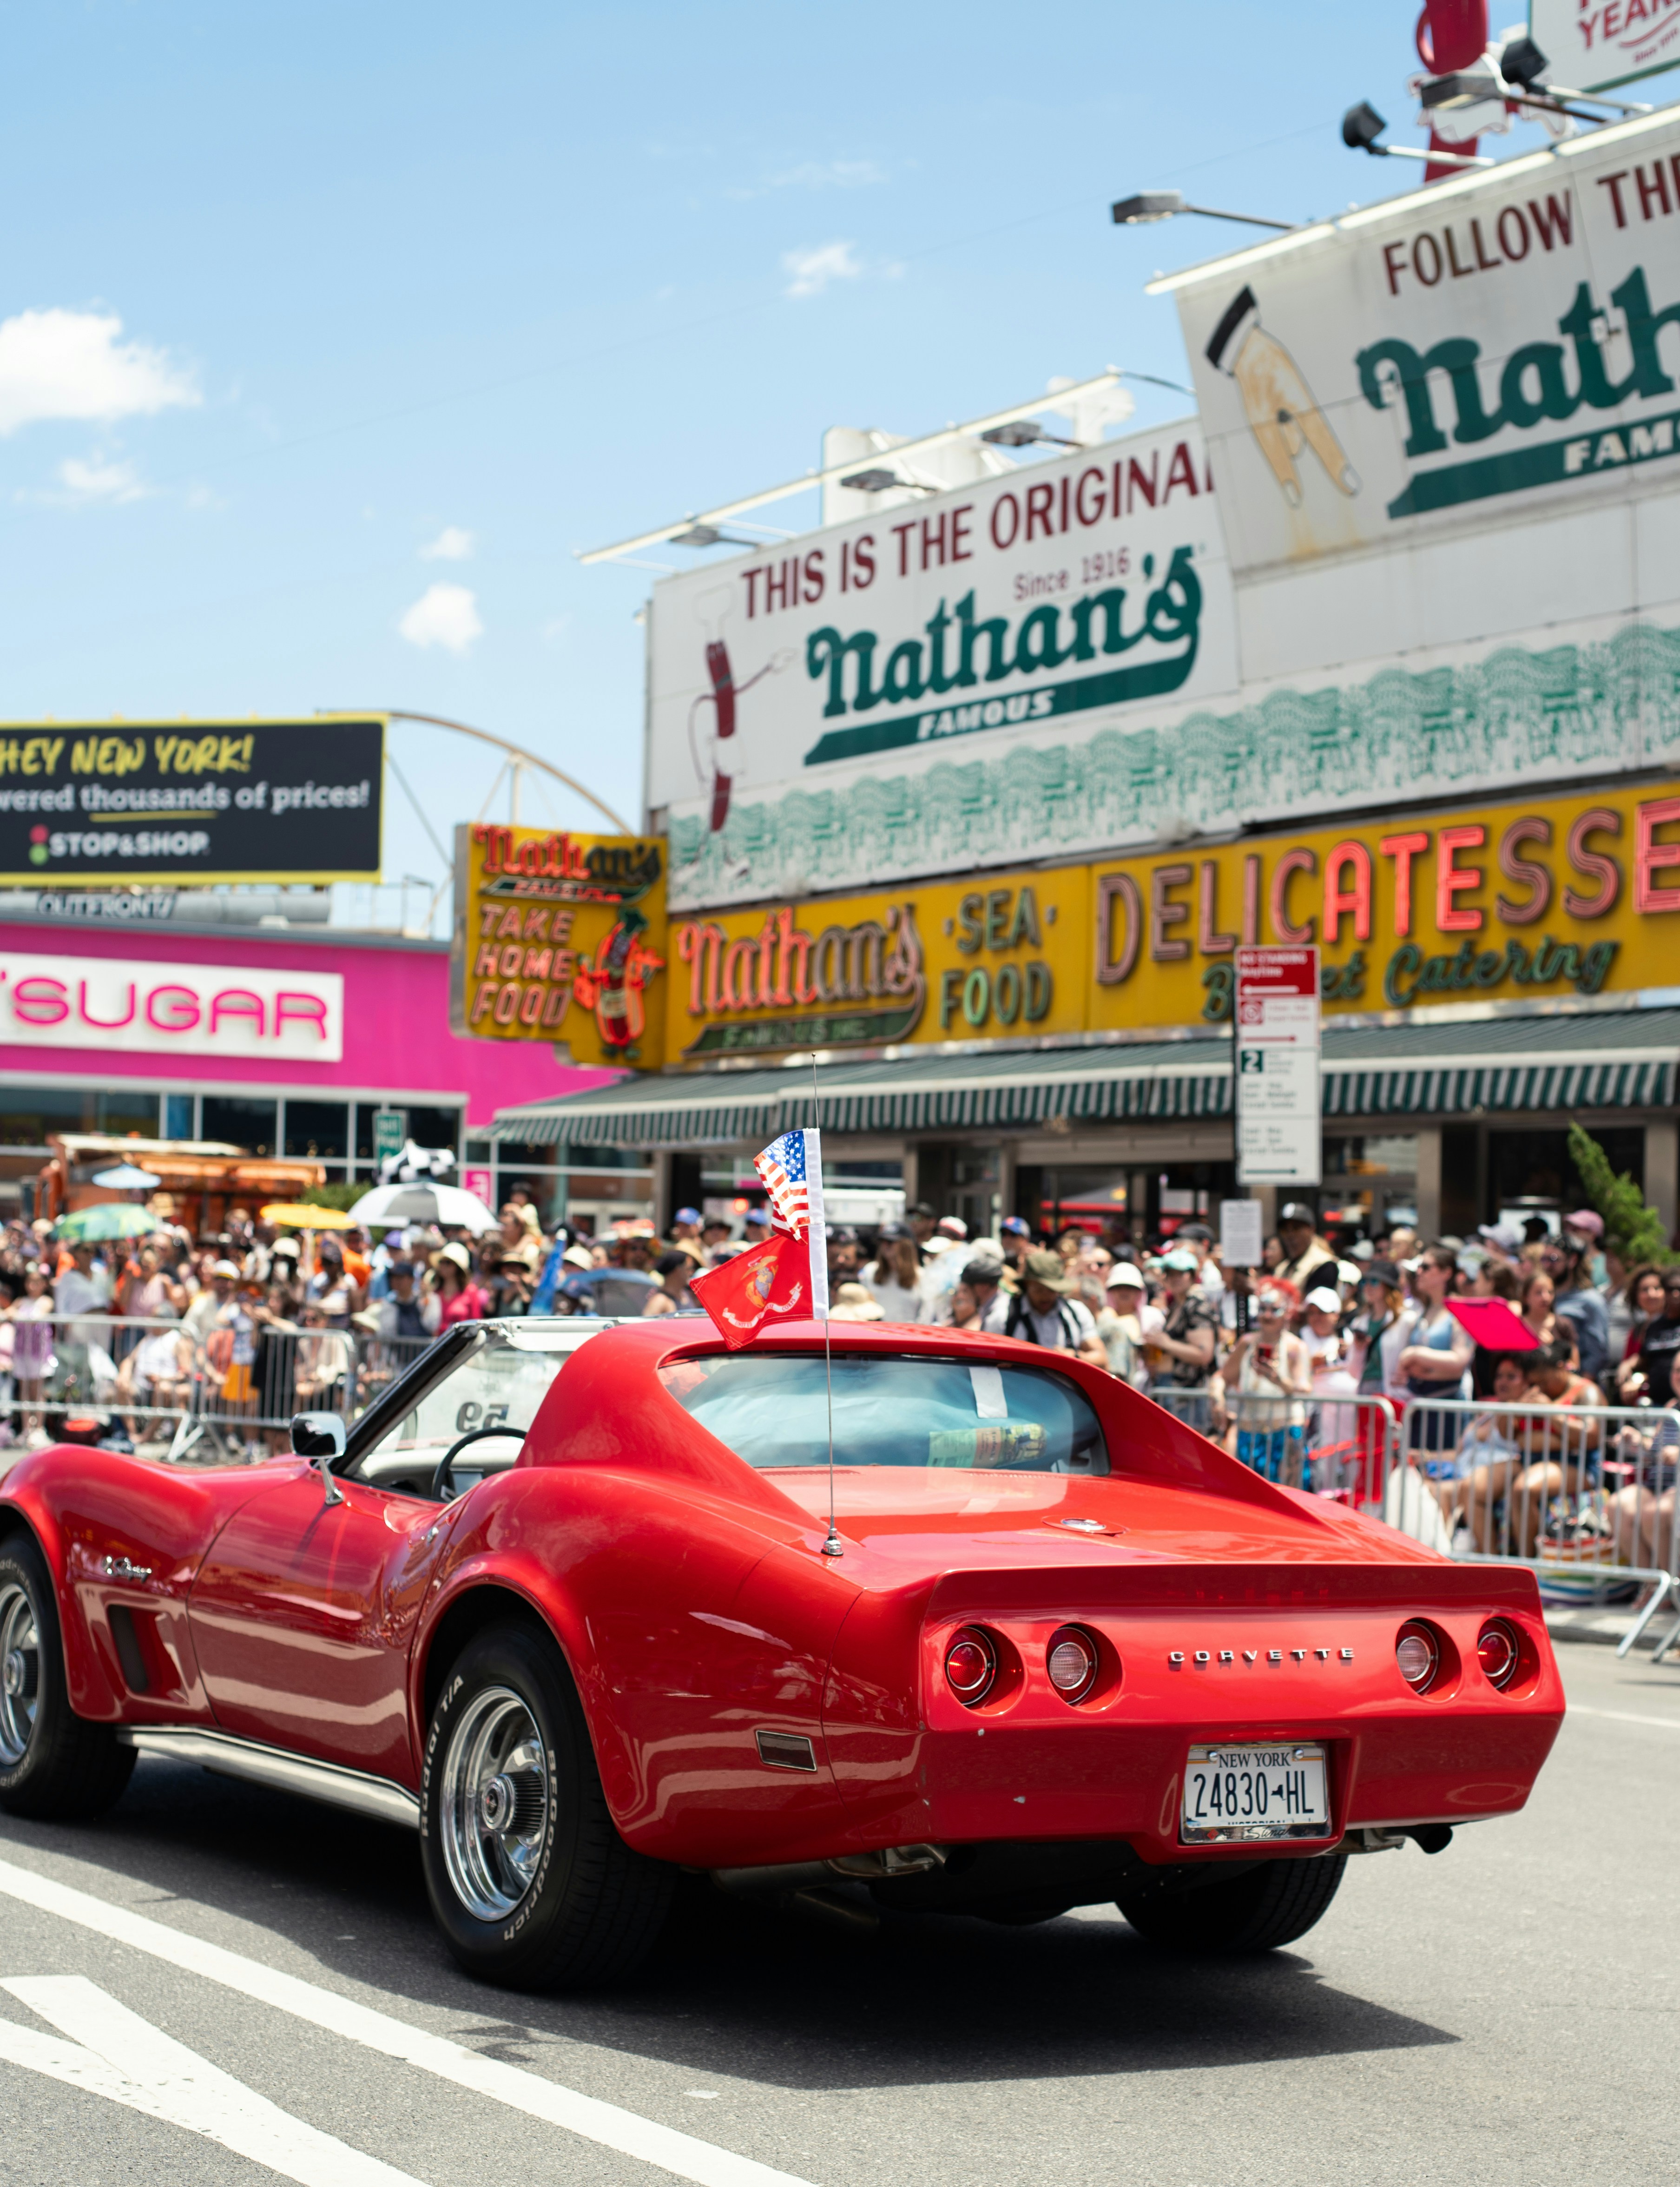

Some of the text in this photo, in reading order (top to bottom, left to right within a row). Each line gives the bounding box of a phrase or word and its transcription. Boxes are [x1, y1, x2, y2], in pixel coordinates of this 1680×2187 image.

[1382, 189, 1574, 296] FOLLOW
[1564, 419, 1680, 474] FAM
[742, 550, 825, 619] THIS
[840, 535, 875, 593] IS
[891, 505, 974, 578] THE
[1014, 547, 1129, 601] Since 1916
[916, 689, 1056, 740] FAMOUS
[70, 735, 146, 777] NEW
[155, 733, 255, 775] YORK!
[80, 781, 231, 810] thousands
[234, 780, 269, 810] of
[270, 779, 371, 816] prices!
[481, 903, 576, 943] TAKE
[956, 886, 1041, 954] SEA
[474, 942, 577, 982] HOME
[1384, 935, 1620, 1008] Catering
[471, 981, 572, 1027] FOOD
[939, 961, 1051, 1028] FOOD
[1244, 1051, 1260, 1072] 2
[1168, 1647, 1356, 1663] CORVETTE
[1219, 1752, 1291, 1768] NEW YORK
